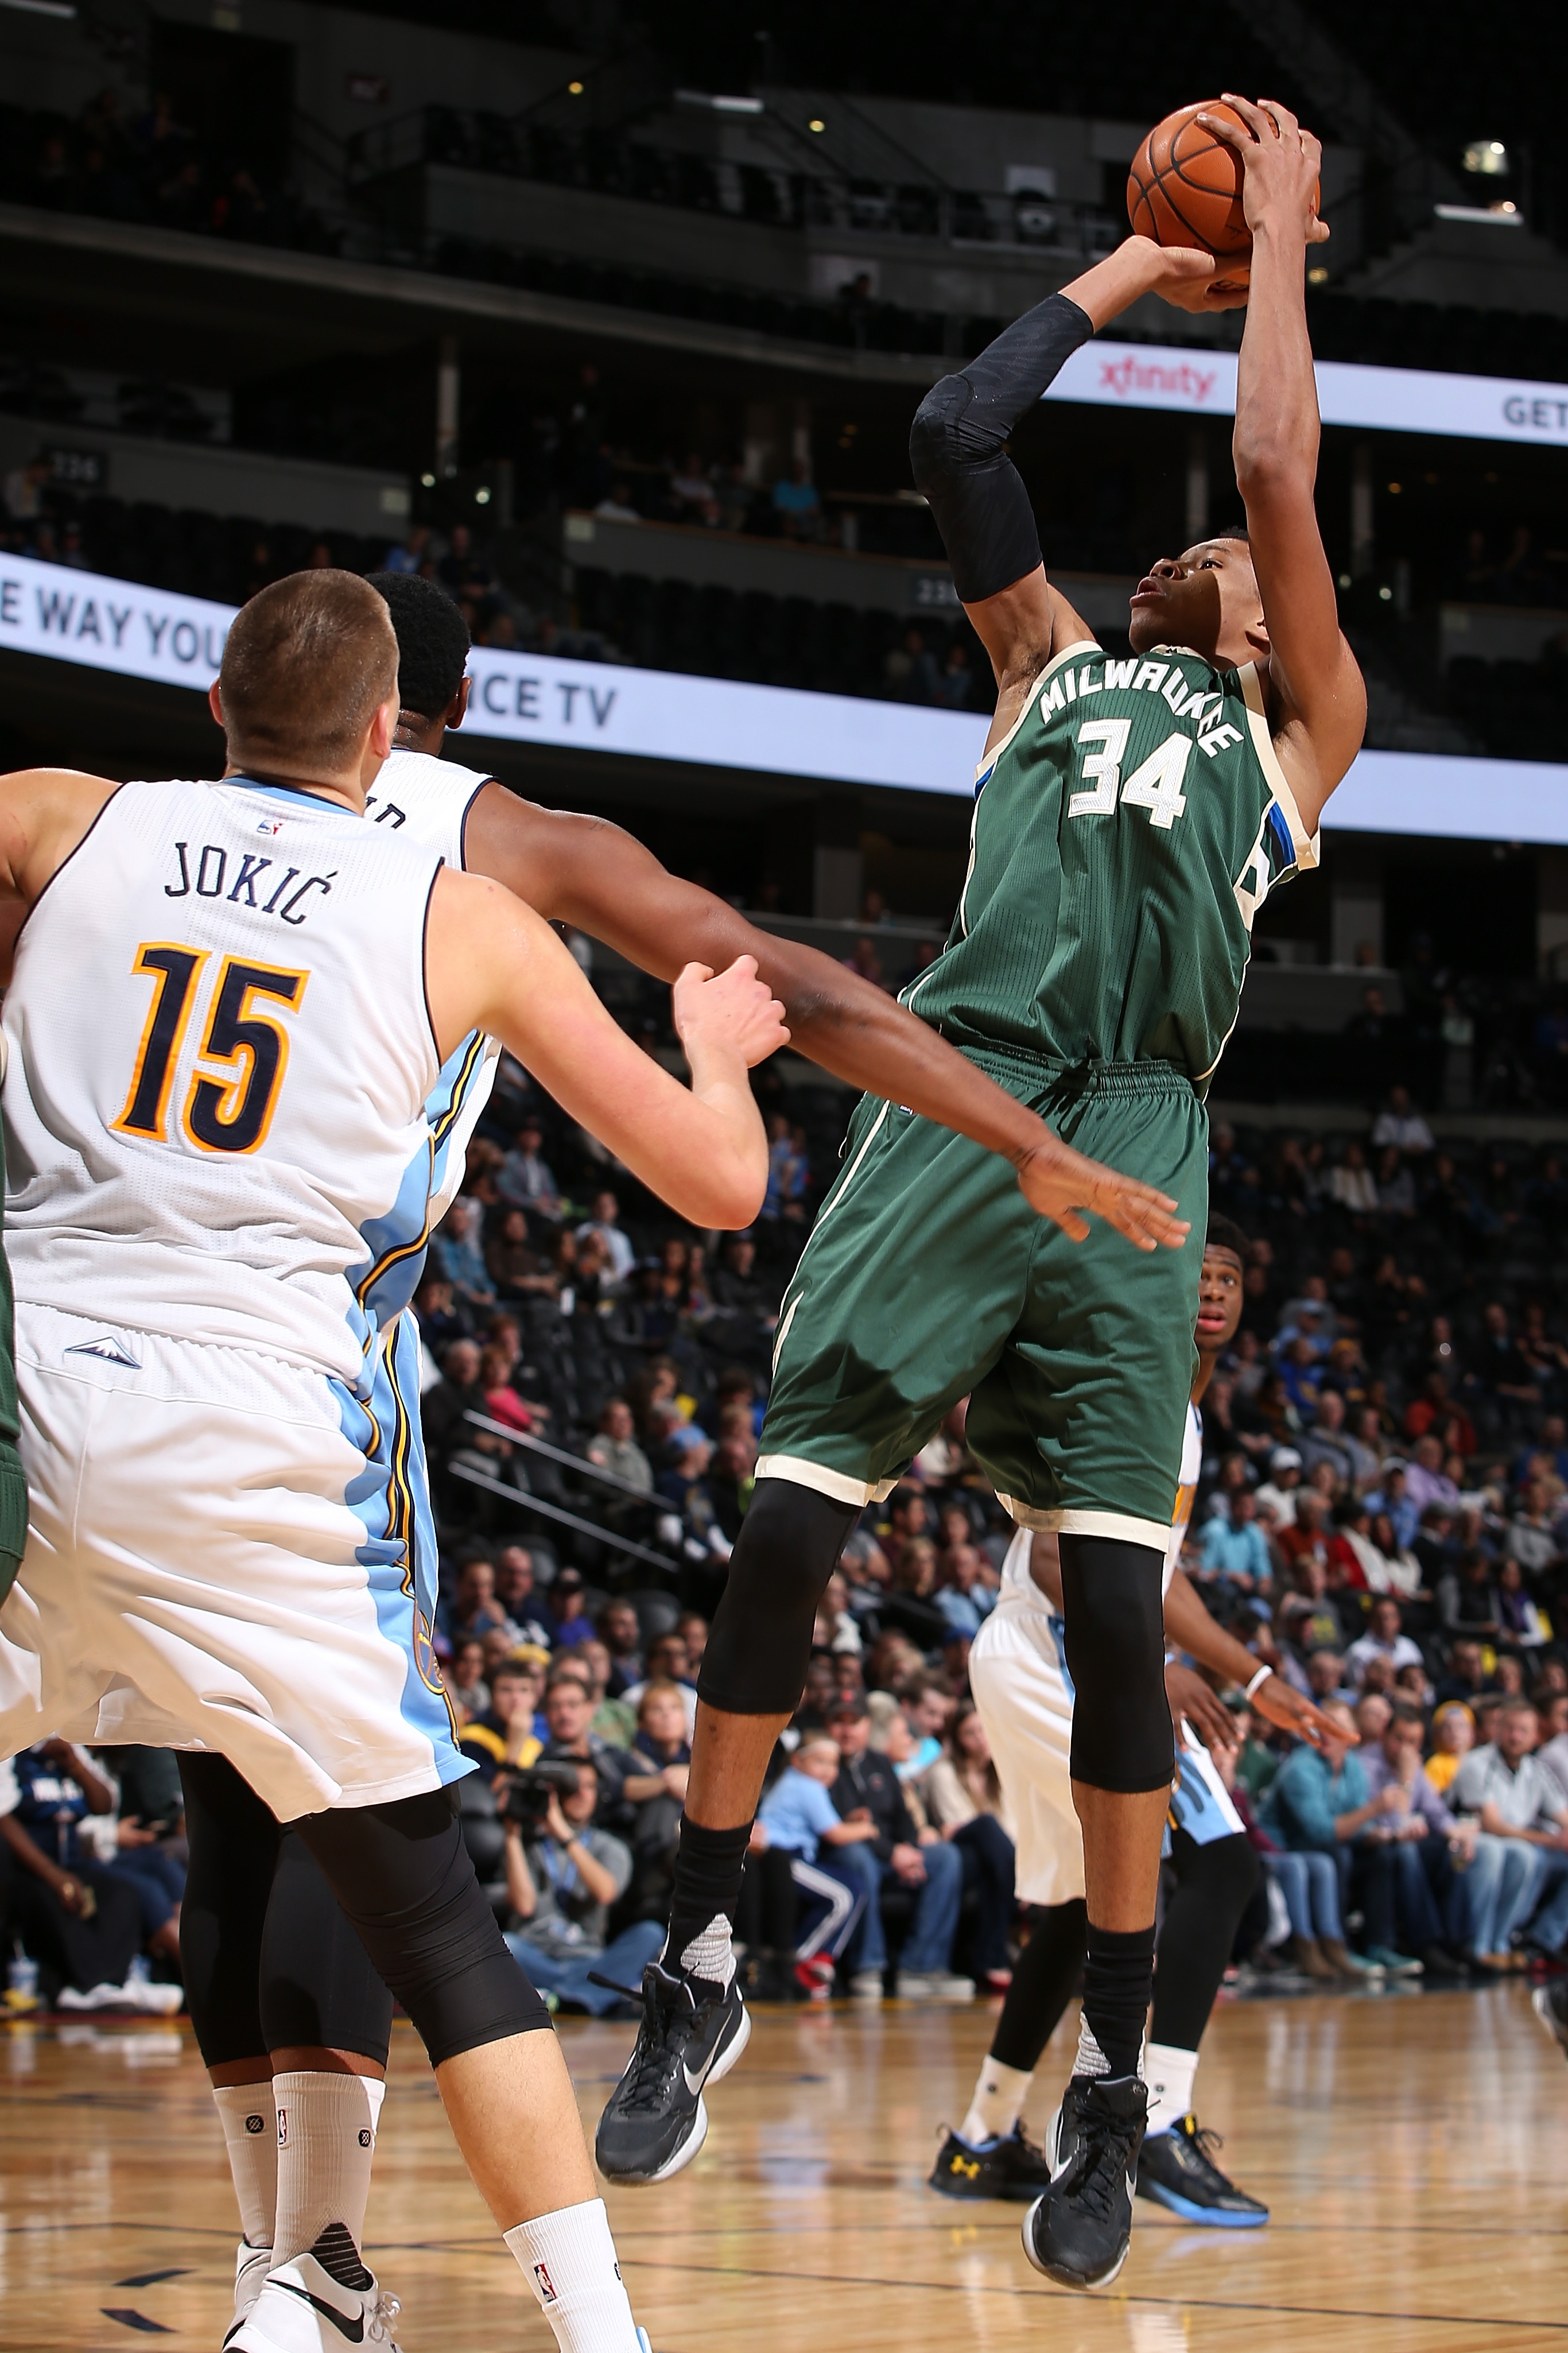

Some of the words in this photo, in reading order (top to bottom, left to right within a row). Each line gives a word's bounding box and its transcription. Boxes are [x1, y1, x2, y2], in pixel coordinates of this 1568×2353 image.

[1100, 354, 1217, 403] xfinity
[1503, 396, 1568, 429] GET
[36, 583, 131, 648] WAY
[557, 681, 618, 727] TV
[1039, 658, 1245, 758] MILWAUKEE
[1068, 718, 1194, 830] 34
[164, 842, 338, 925] JOKIĆ
[108, 941, 312, 1154] 15
